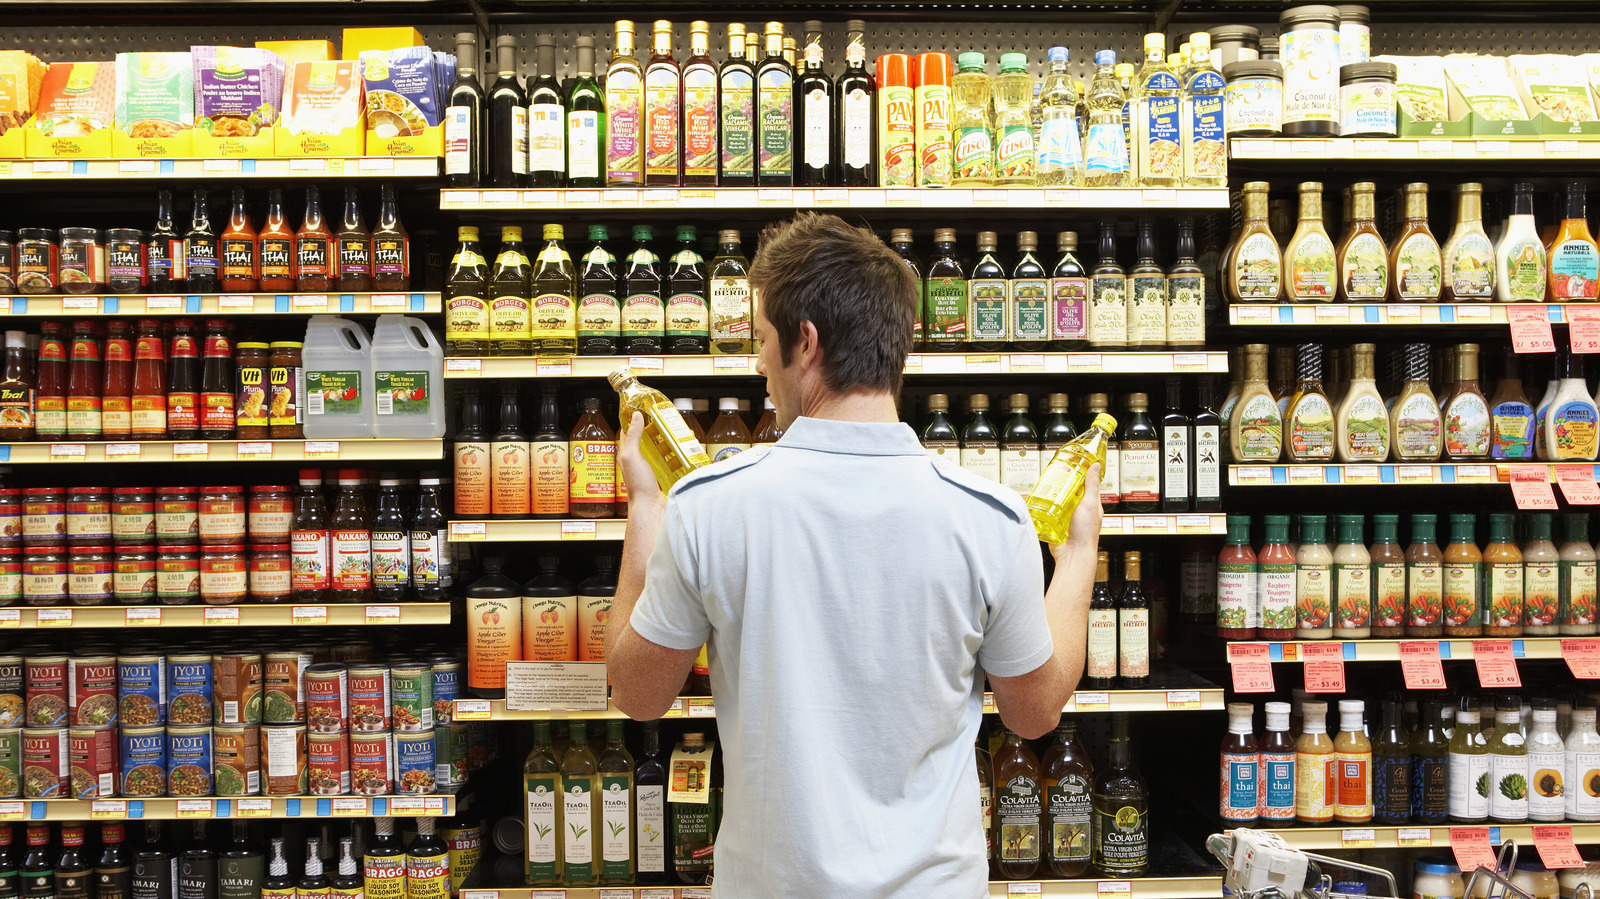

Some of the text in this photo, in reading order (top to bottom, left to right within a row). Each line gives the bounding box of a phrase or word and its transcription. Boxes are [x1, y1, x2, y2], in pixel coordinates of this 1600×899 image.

[956, 136, 988, 160] Crisco
[999, 136, 1030, 160] Crisco
[111, 252, 138, 263] THAI
[224, 252, 251, 261] THAI
[262, 252, 288, 261] THAI
[298, 252, 323, 261] THAI
[341, 251, 367, 260] THAI
[376, 250, 402, 259] THAI
[452, 300, 480, 308] BORGES
[495, 300, 523, 308] BORGES
[538, 298, 565, 306] BORGES
[243, 385, 260, 393] Plum
[272, 385, 286, 393] Plum
[1236, 782, 1254, 791] thai
[1273, 780, 1290, 790] thai
[1343, 779, 1361, 789] thai
[1000, 795, 1040, 805] COLAVITA
[1051, 793, 1091, 803] COLAVITA
[1108, 832, 1144, 842] COLAVITA
[366, 869, 403, 877] BRAGG
[408, 868, 443, 877] BRAGG
